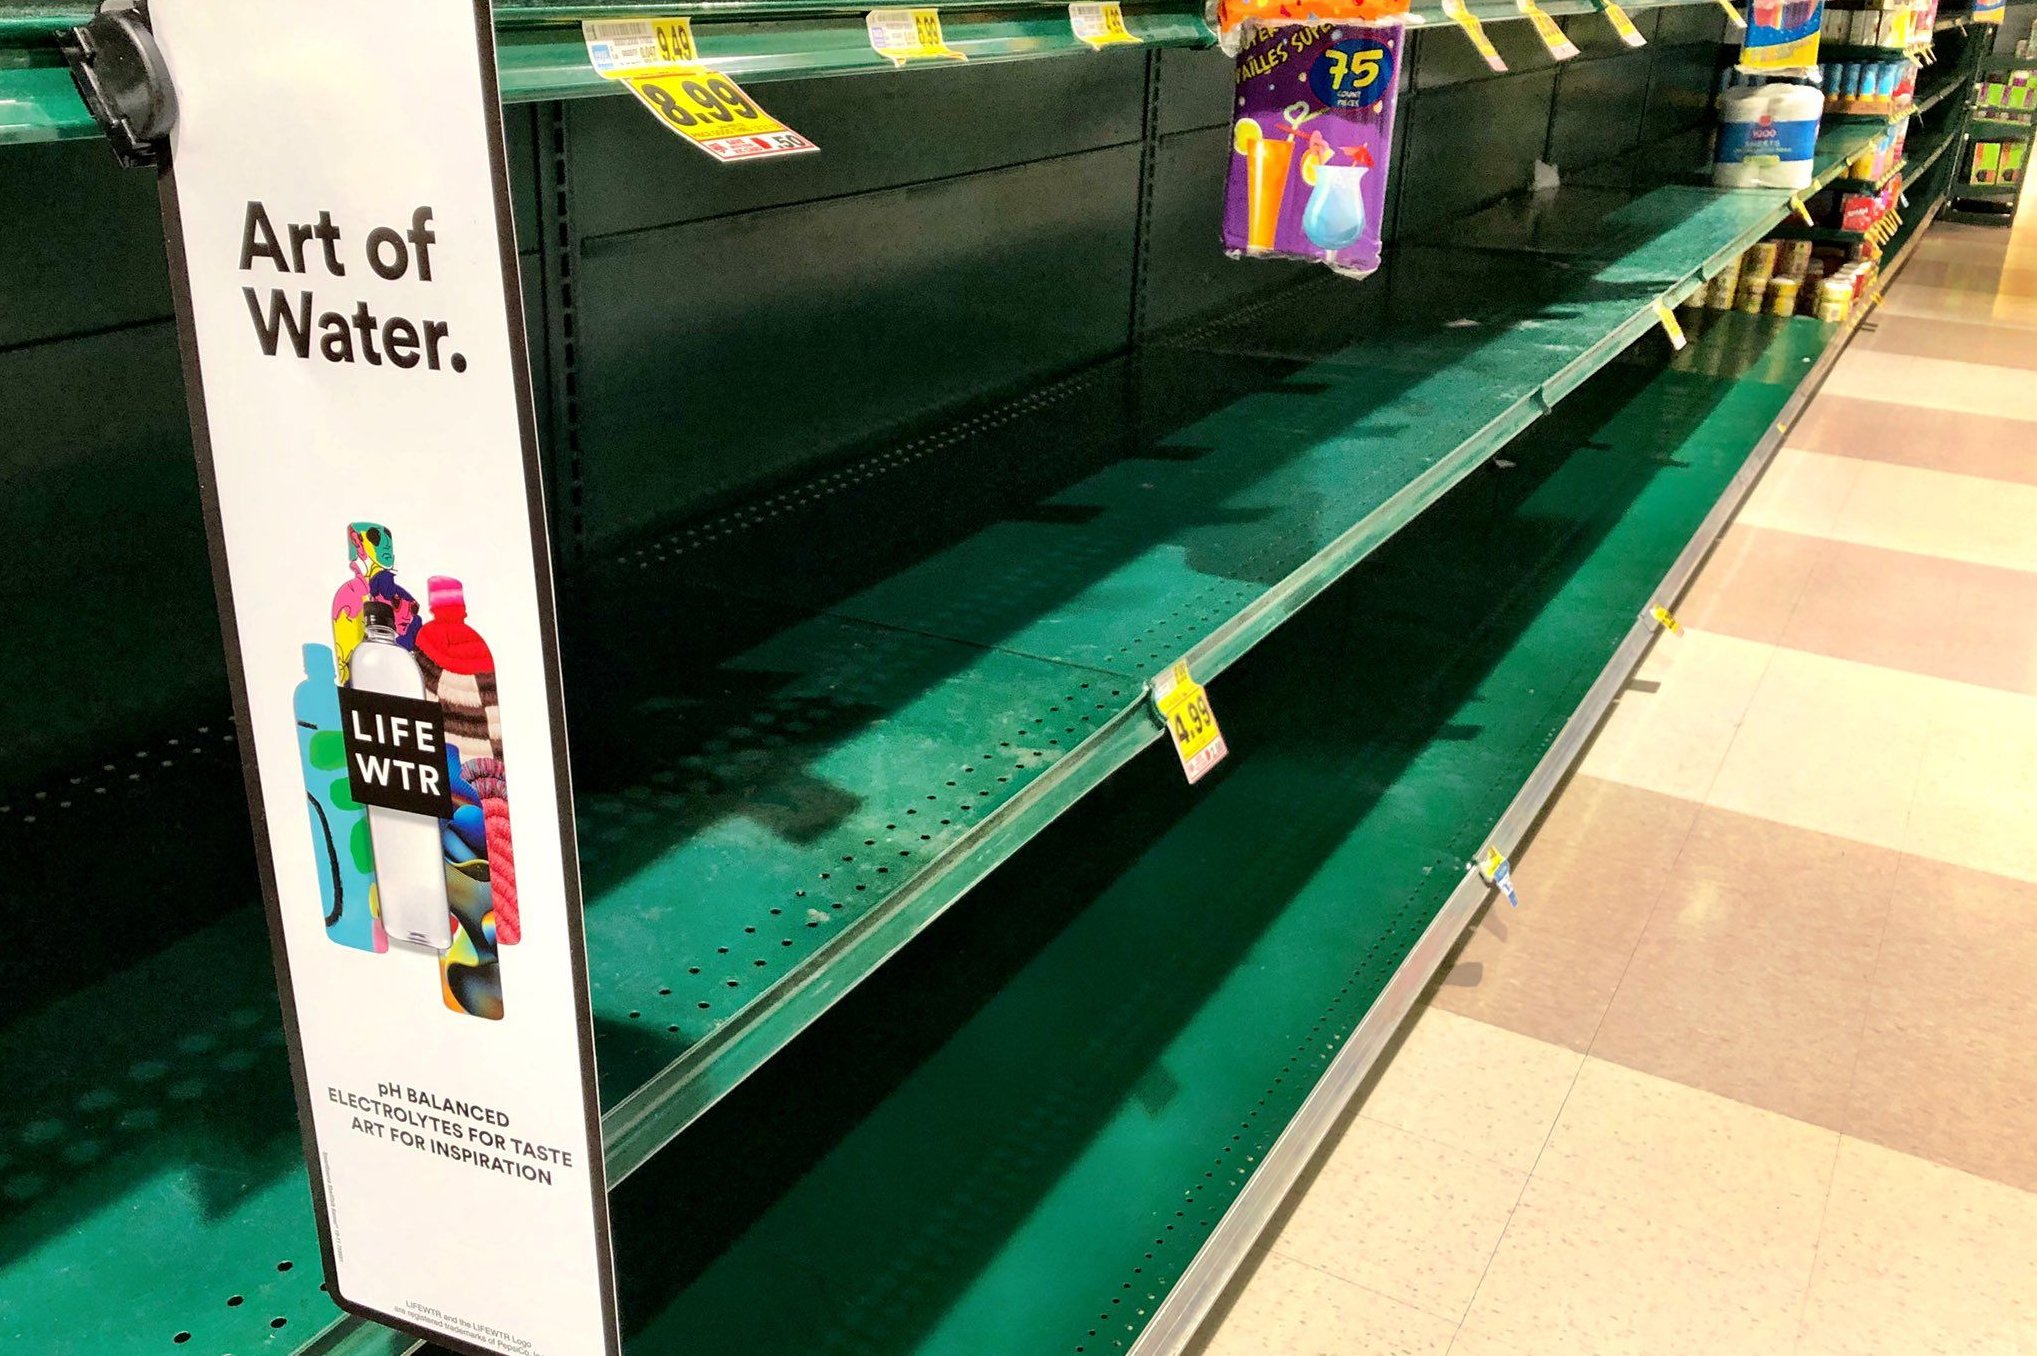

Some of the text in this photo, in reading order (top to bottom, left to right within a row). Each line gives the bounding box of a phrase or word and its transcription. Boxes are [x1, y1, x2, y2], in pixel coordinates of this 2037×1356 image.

[656, 24, 693, 62] 9.49
[1325, 48, 1384, 90] 75
[641, 78, 759, 127] 8.99
[771, 134, 806, 150] .50
[239, 200, 437, 282] Art of
[241, 286, 468, 374] Water.
[350, 709, 437, 753] LIFE
[1174, 695, 1212, 744] 4.99
[354, 752, 442, 797] WTR
[327, 1086, 573, 1168] ELECTROLYTES FOR TASTE
[377, 1082, 510, 1128] pH BALANCED
[351, 1116, 553, 1186] ART FOR INSPIRATION
[394, 1304, 406, 1315] are
[407, 1309, 443, 1328] registered
[444, 1321, 487, 1343] trademarks
[487, 1336, 496, 1346] of
[405, 1299, 532, 1349] LIFEWTR and the LIFEWTR Logo
